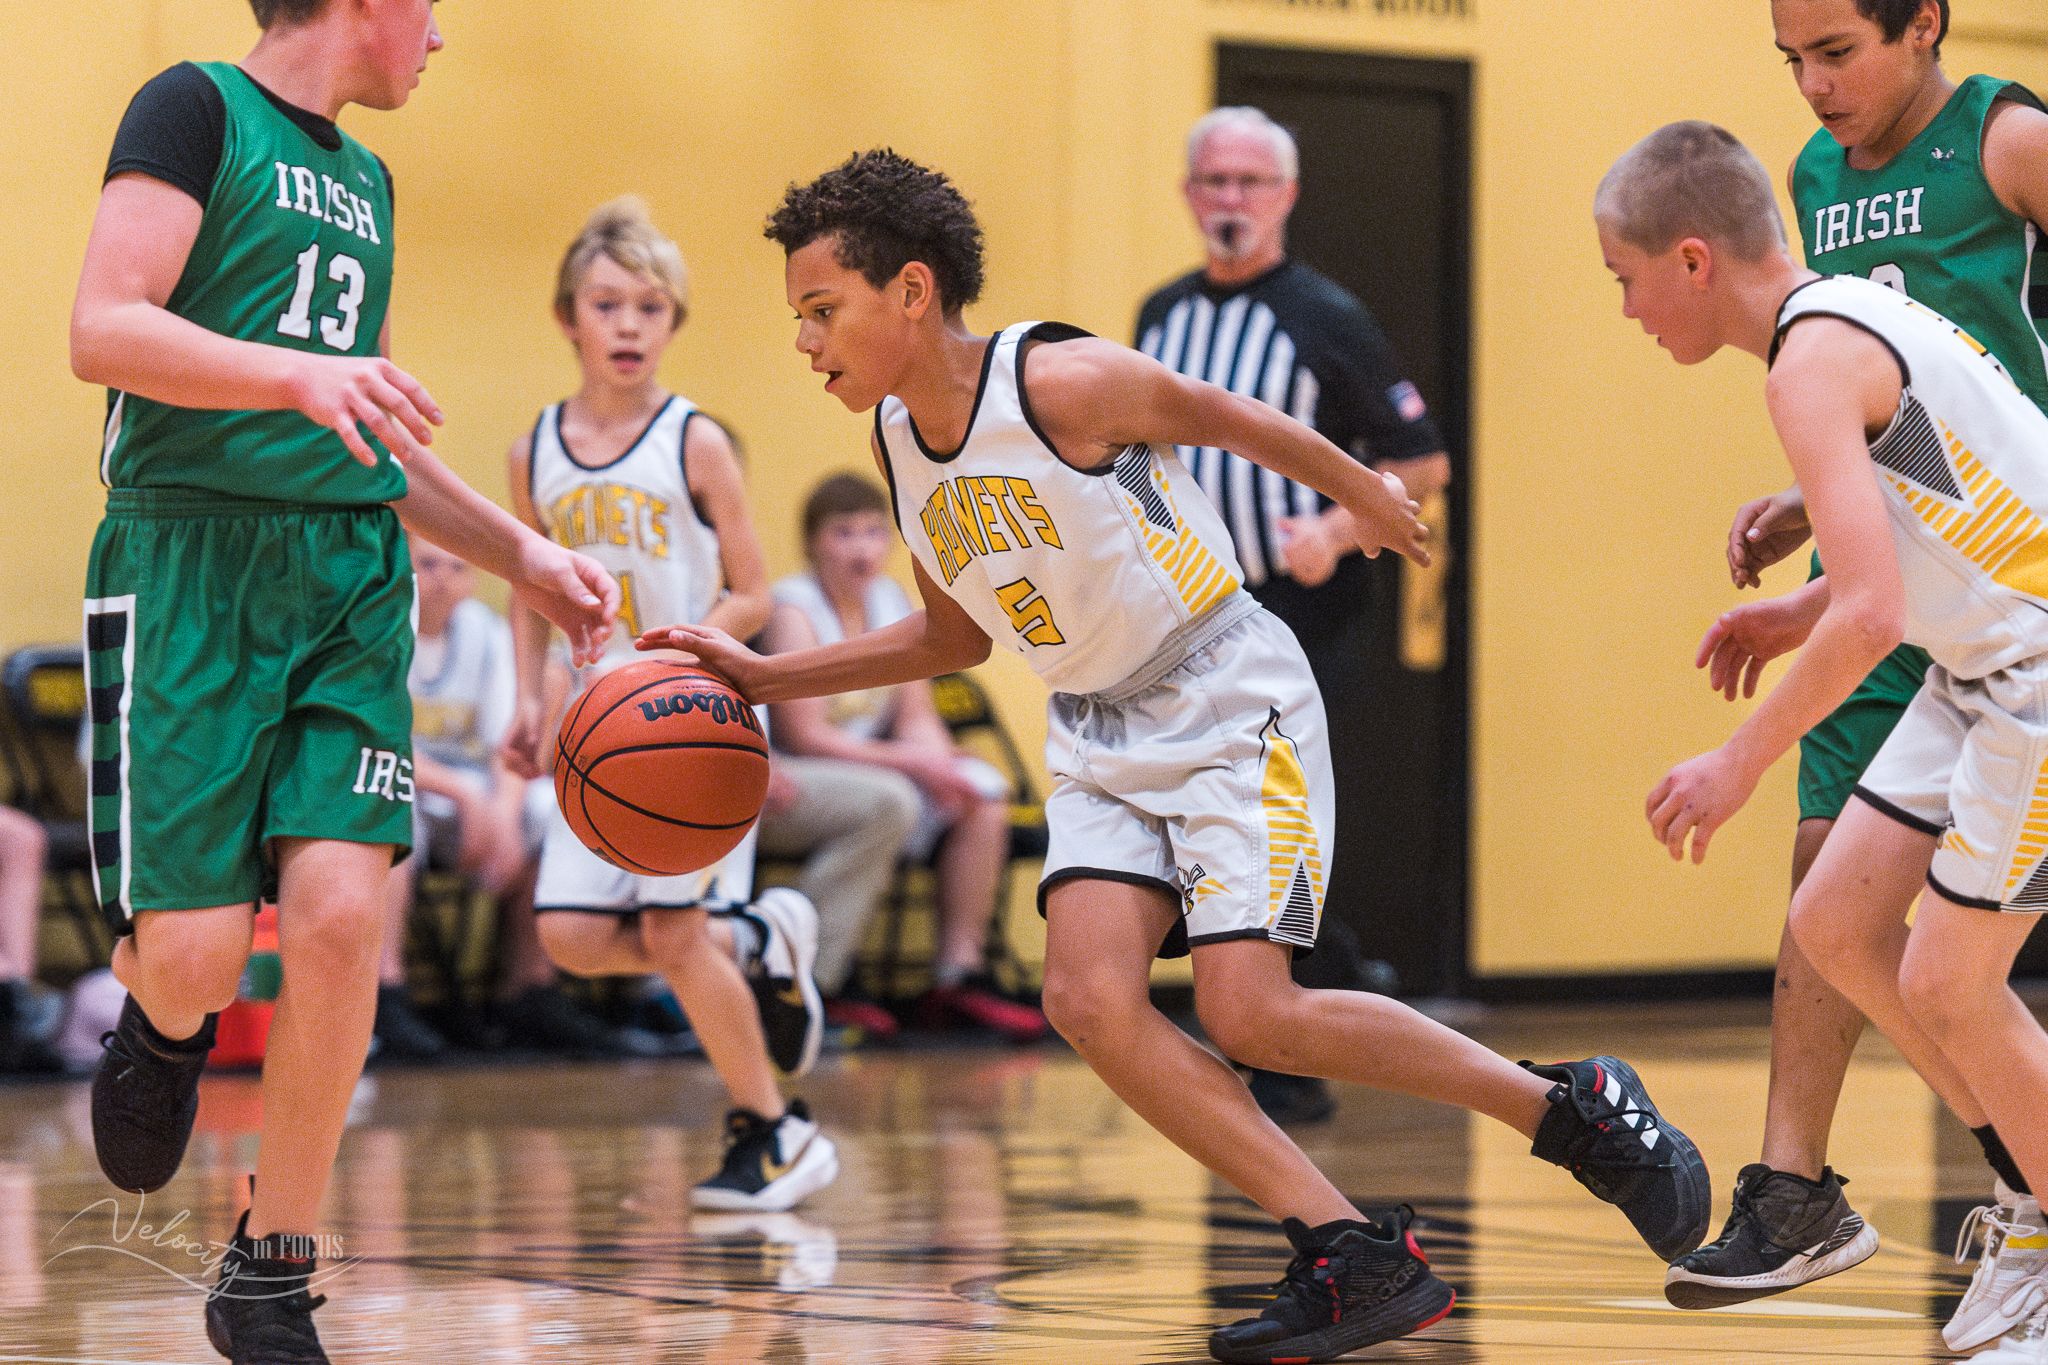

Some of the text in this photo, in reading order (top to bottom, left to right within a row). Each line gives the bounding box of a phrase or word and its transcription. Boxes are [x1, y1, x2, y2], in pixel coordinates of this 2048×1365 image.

[275, 161, 381, 245] IRISH
[1813, 186, 1924, 256] IRISH
[276, 242, 366, 351] 13
[920, 476, 1064, 587] HONETS
[994, 576, 1066, 647] 5
[637, 690, 766, 740] Wilson
